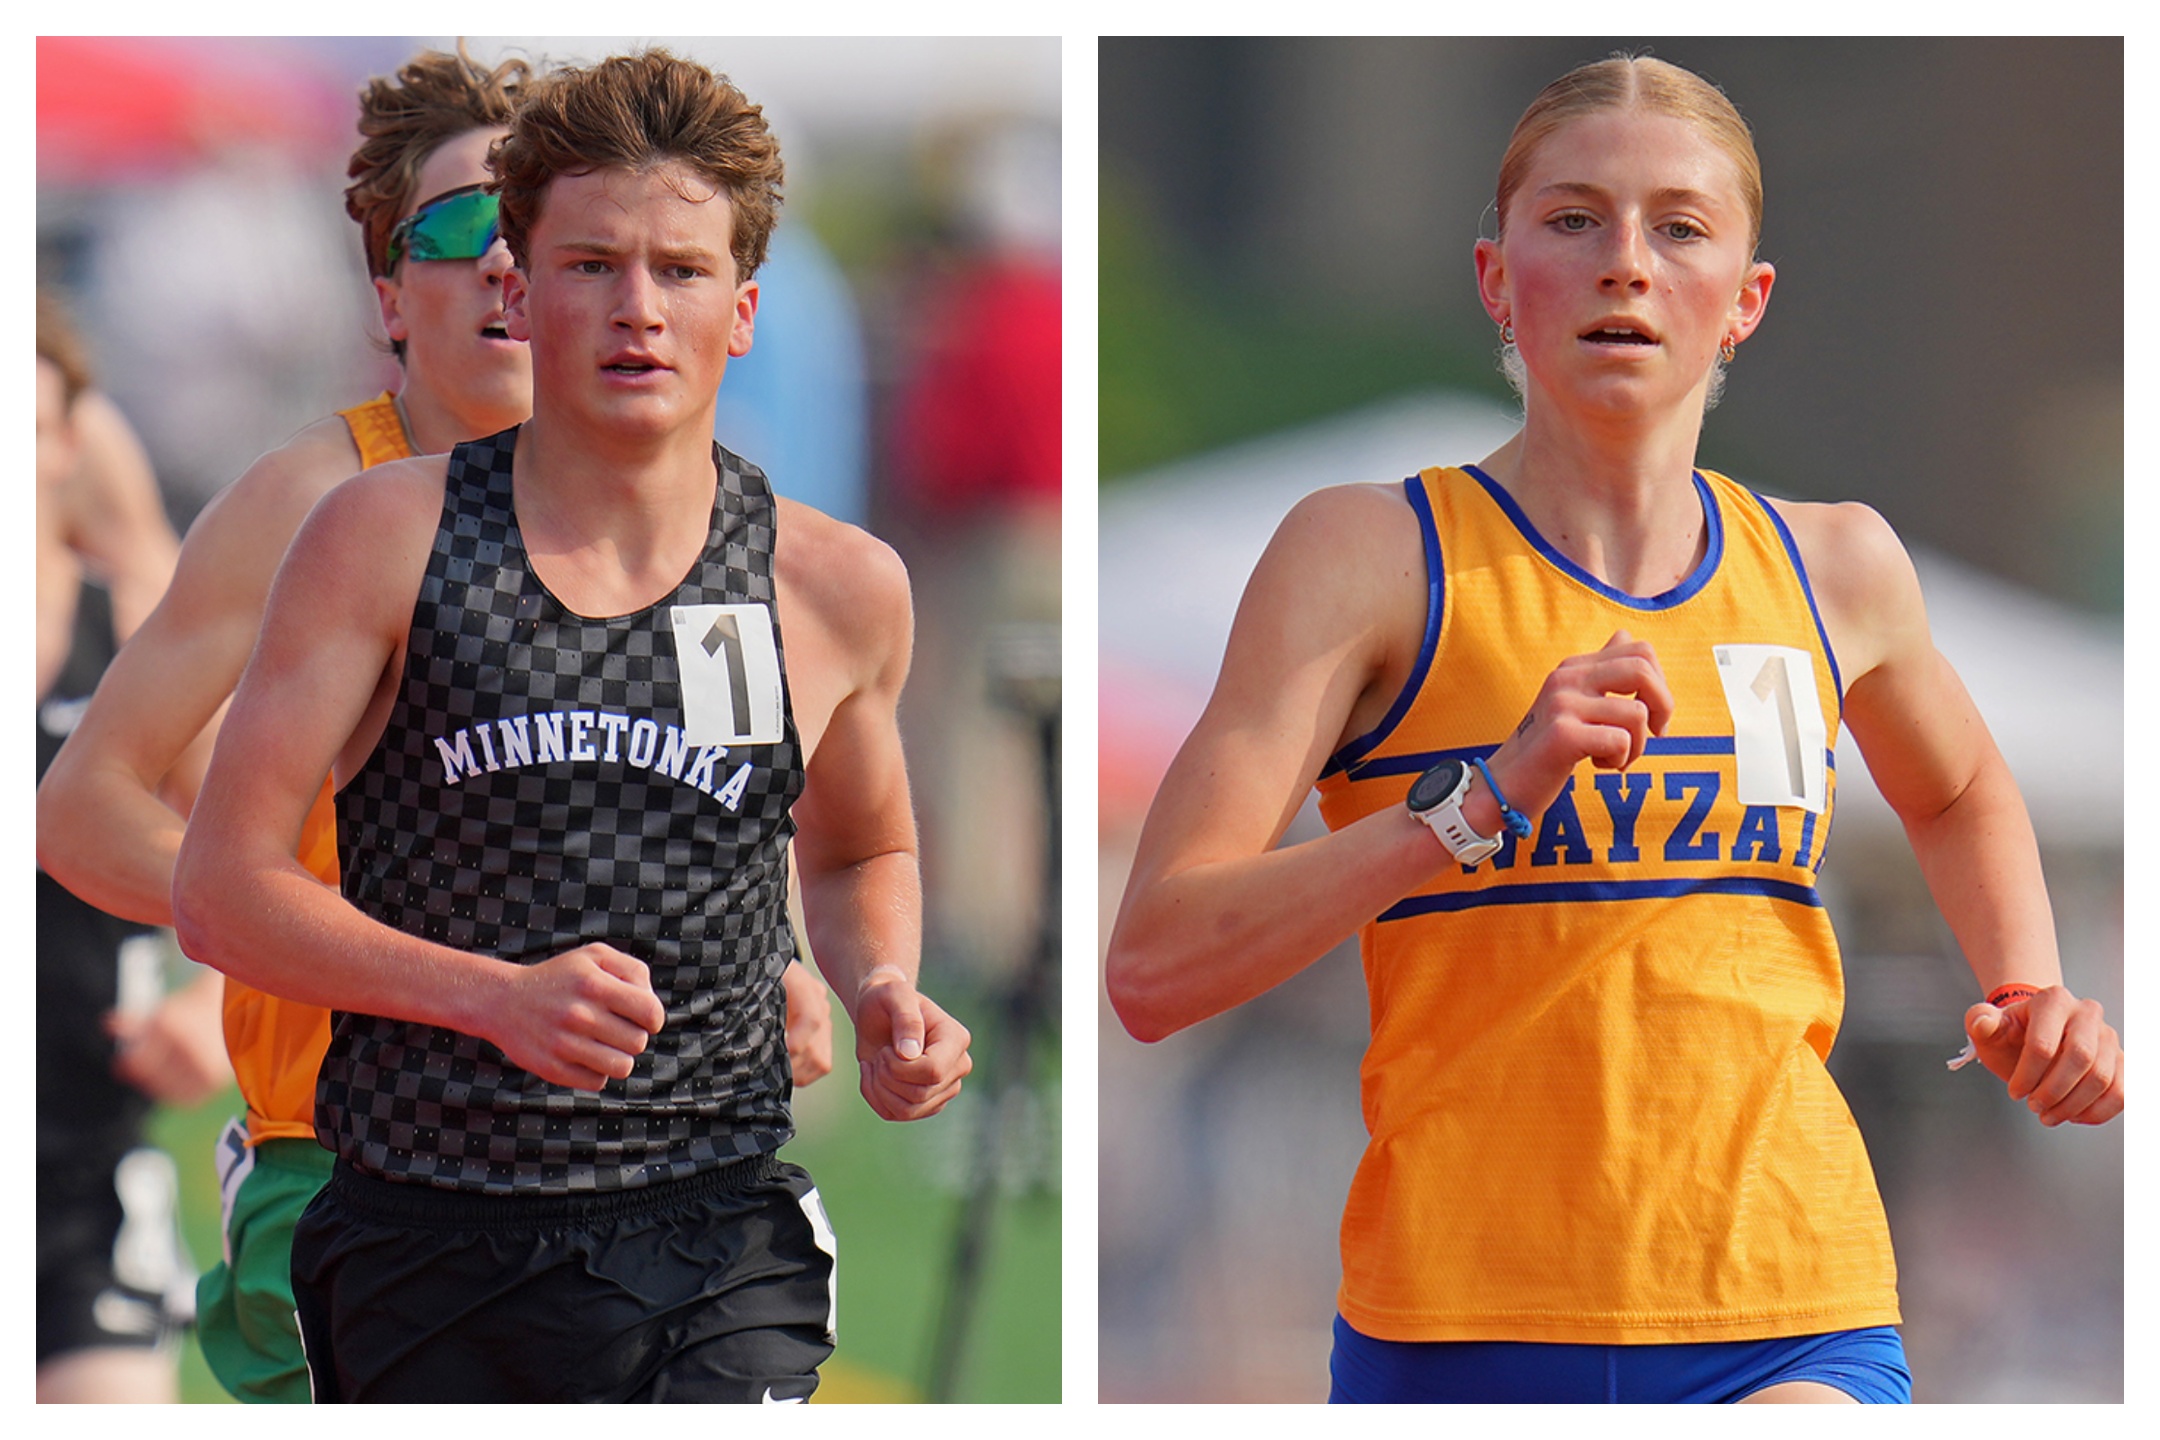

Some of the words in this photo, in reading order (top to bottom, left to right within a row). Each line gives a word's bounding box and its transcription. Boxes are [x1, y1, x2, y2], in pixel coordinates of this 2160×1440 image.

[700, 613, 752, 737] 1
[1750, 655, 1806, 799] 1
[434, 710, 754, 813] MINNETONKA
